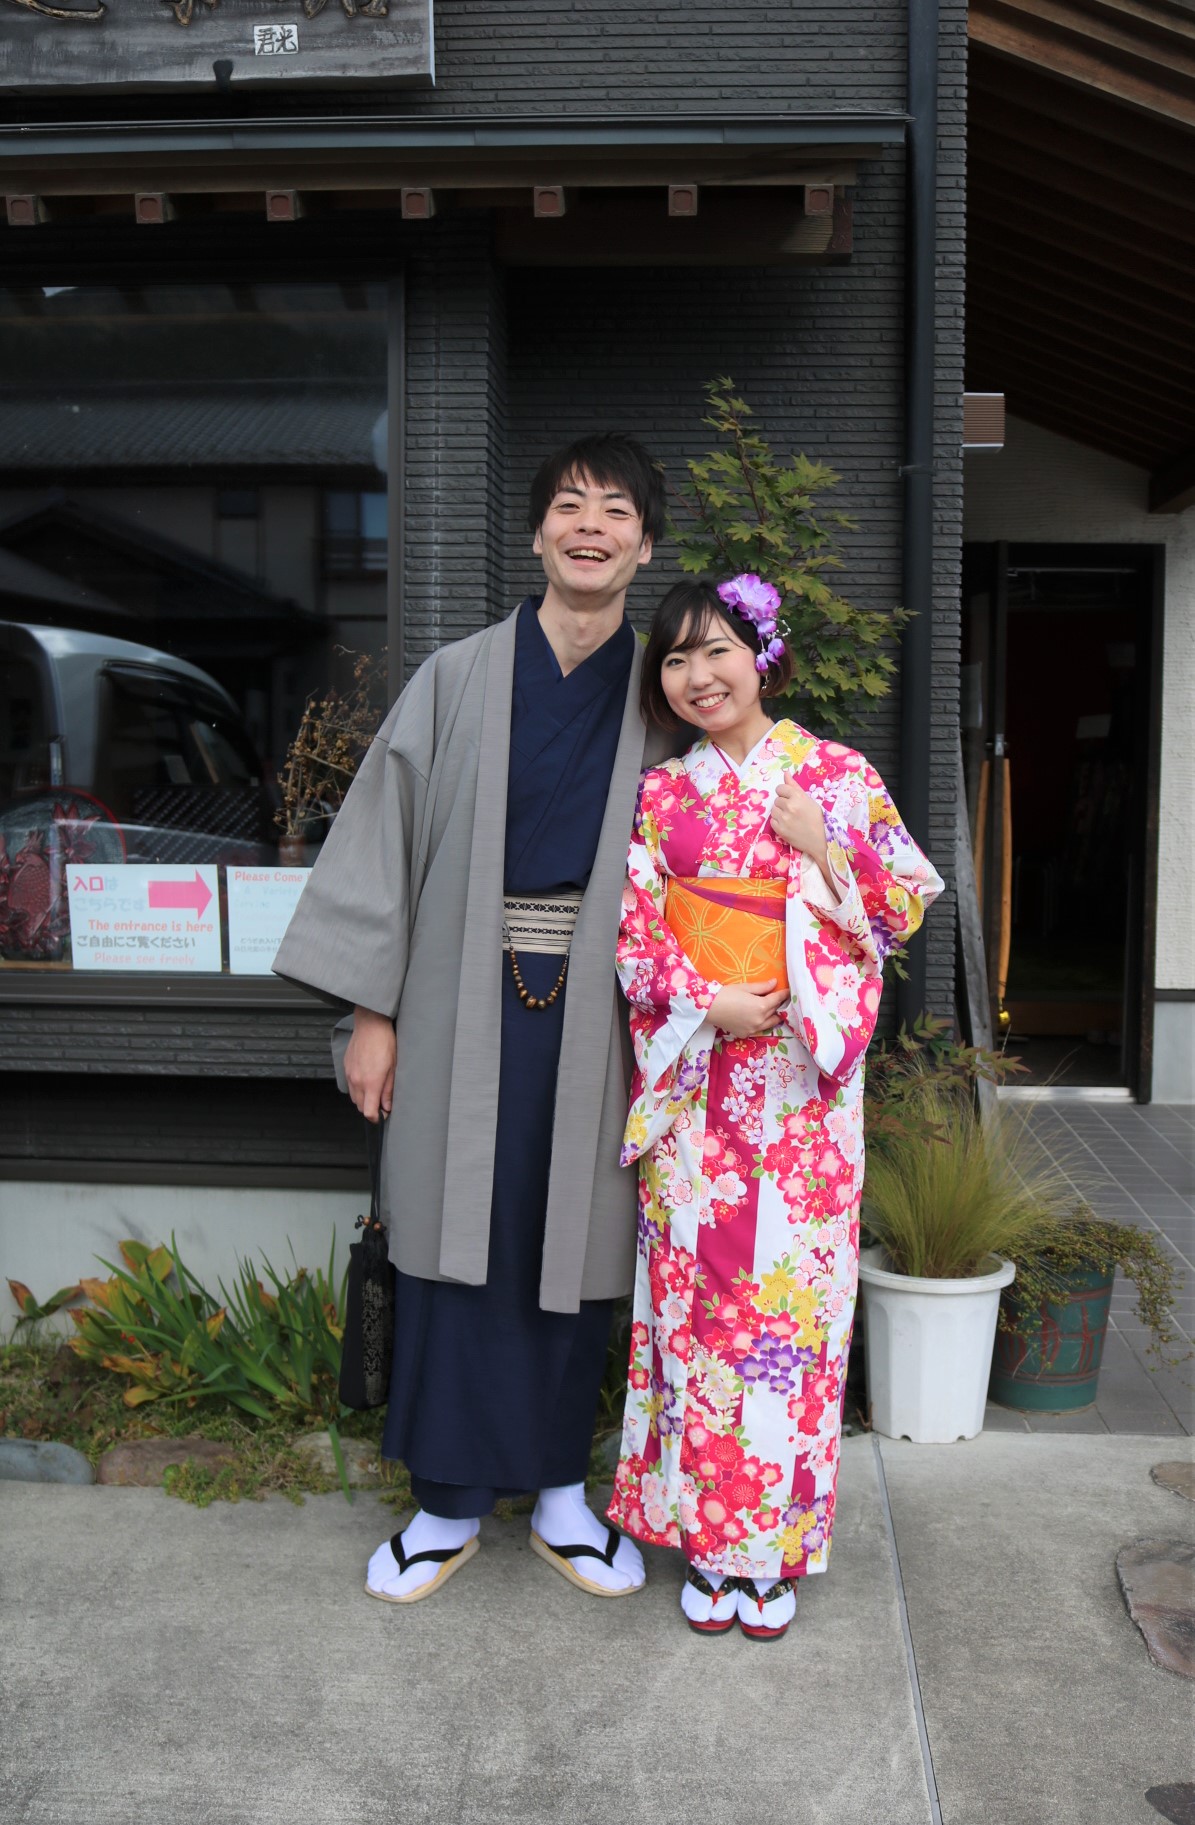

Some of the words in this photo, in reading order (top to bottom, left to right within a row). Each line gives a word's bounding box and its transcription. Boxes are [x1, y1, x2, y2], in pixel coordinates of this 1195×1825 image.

[234, 871, 270, 882] Please
[274, 871, 304, 882] Come
[73, 876, 119, 892] 入口は
[74, 897, 146, 913] こちらです
[88, 919, 110, 931] The
[114, 920, 168, 932] entrance
[171, 920, 182, 932] is
[186, 920, 214, 933] here
[76, 935, 196, 949] ご自由にご覧ください
[94, 952, 132, 964] Please
[136, 954, 155, 965] see
[160, 953, 195, 966] freely
